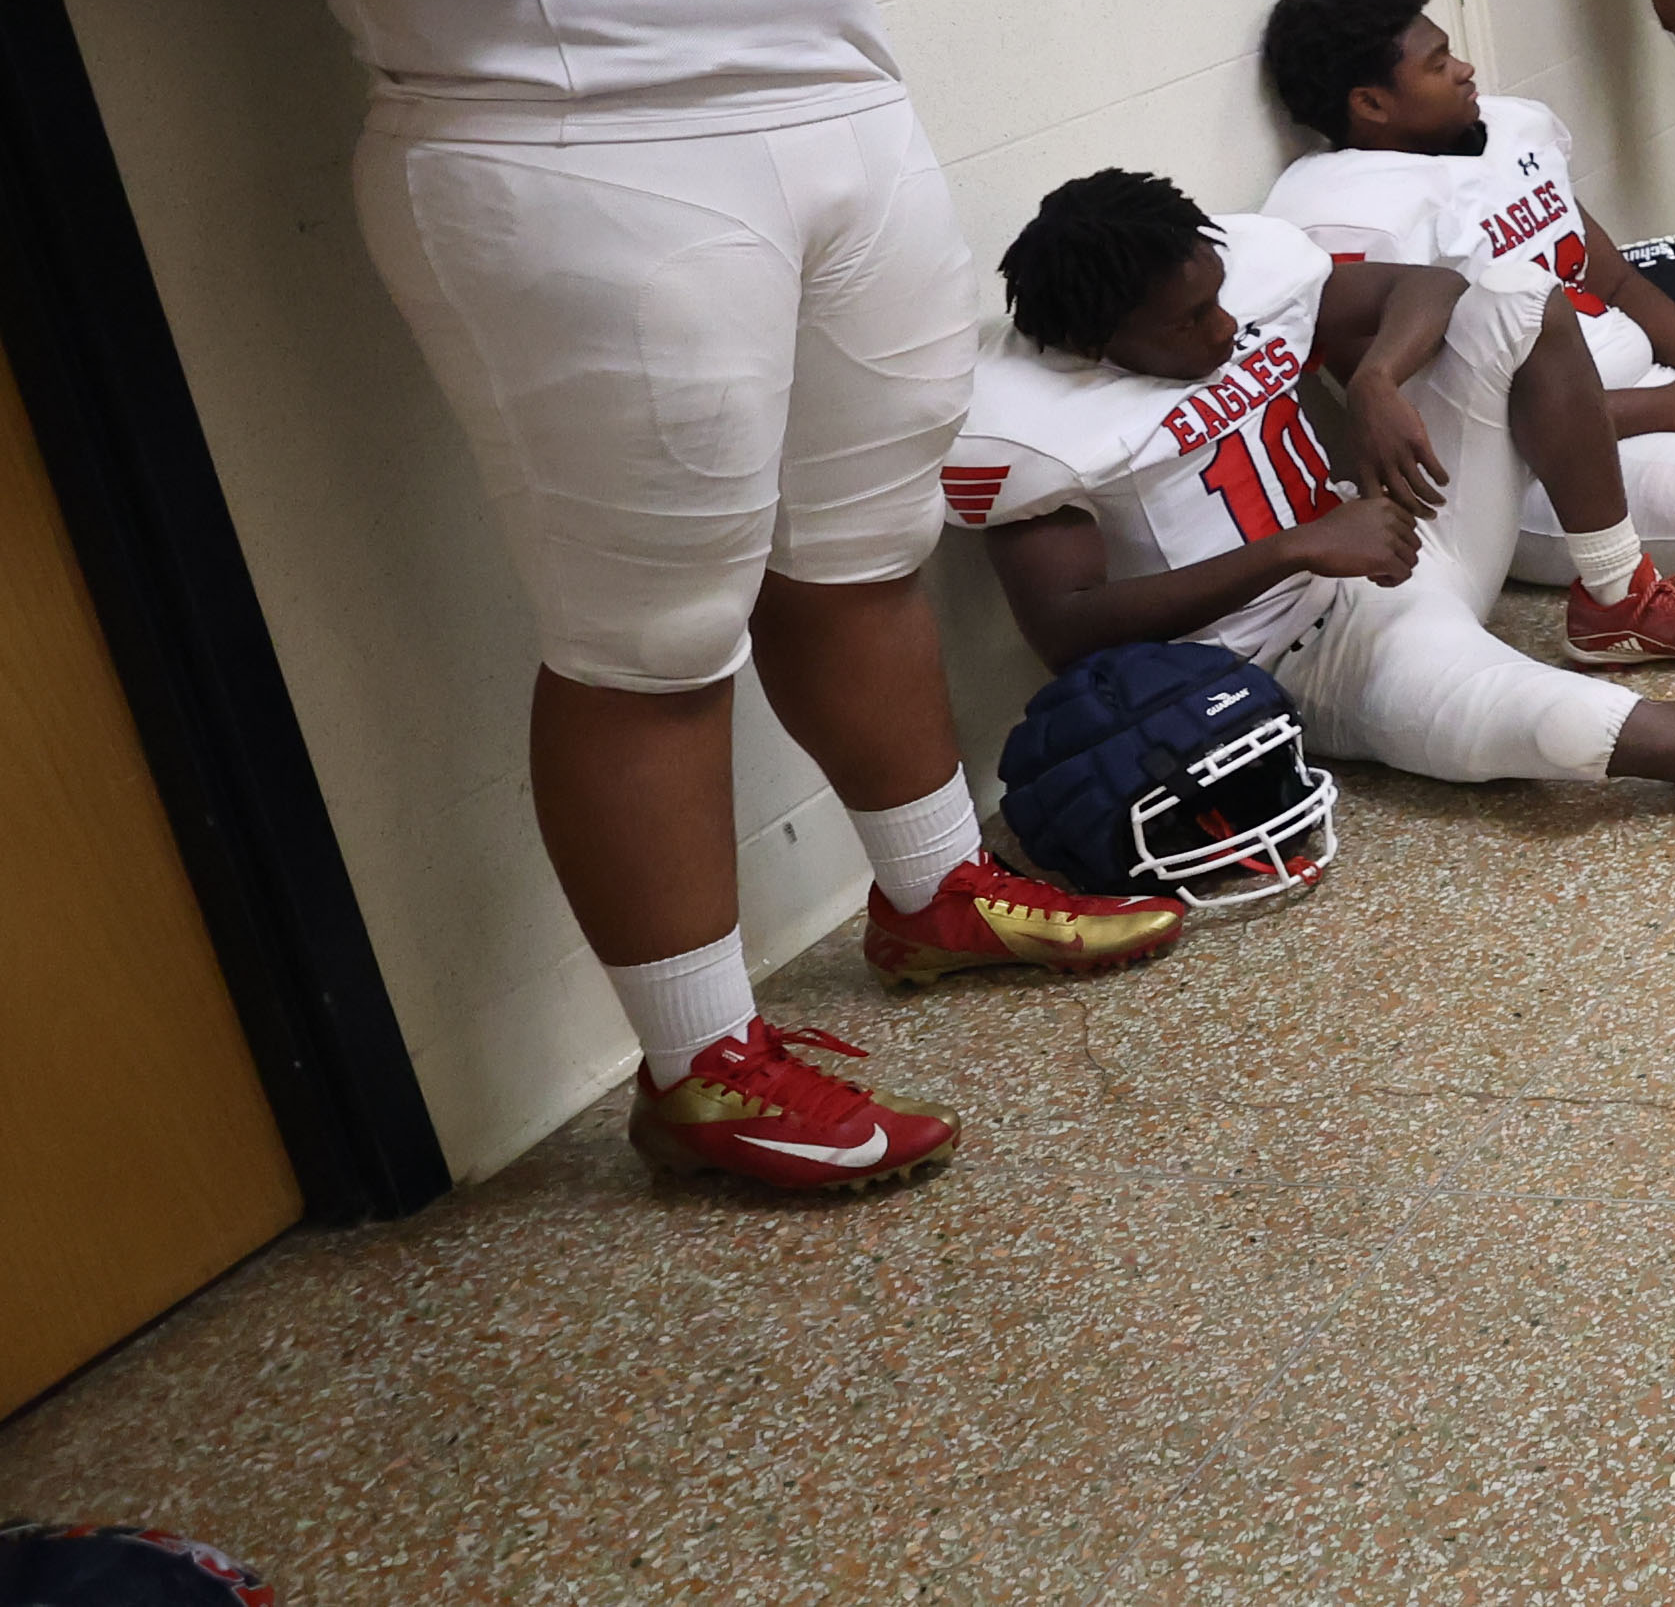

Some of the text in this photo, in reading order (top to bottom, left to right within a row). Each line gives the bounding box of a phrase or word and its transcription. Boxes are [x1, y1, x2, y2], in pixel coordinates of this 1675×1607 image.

[1479, 180, 1568, 258] EAGLES
[1161, 337, 1300, 457] EAGLES
[1198, 392, 1344, 544] 10
[1206, 687, 1250, 716] GUARDIAN
